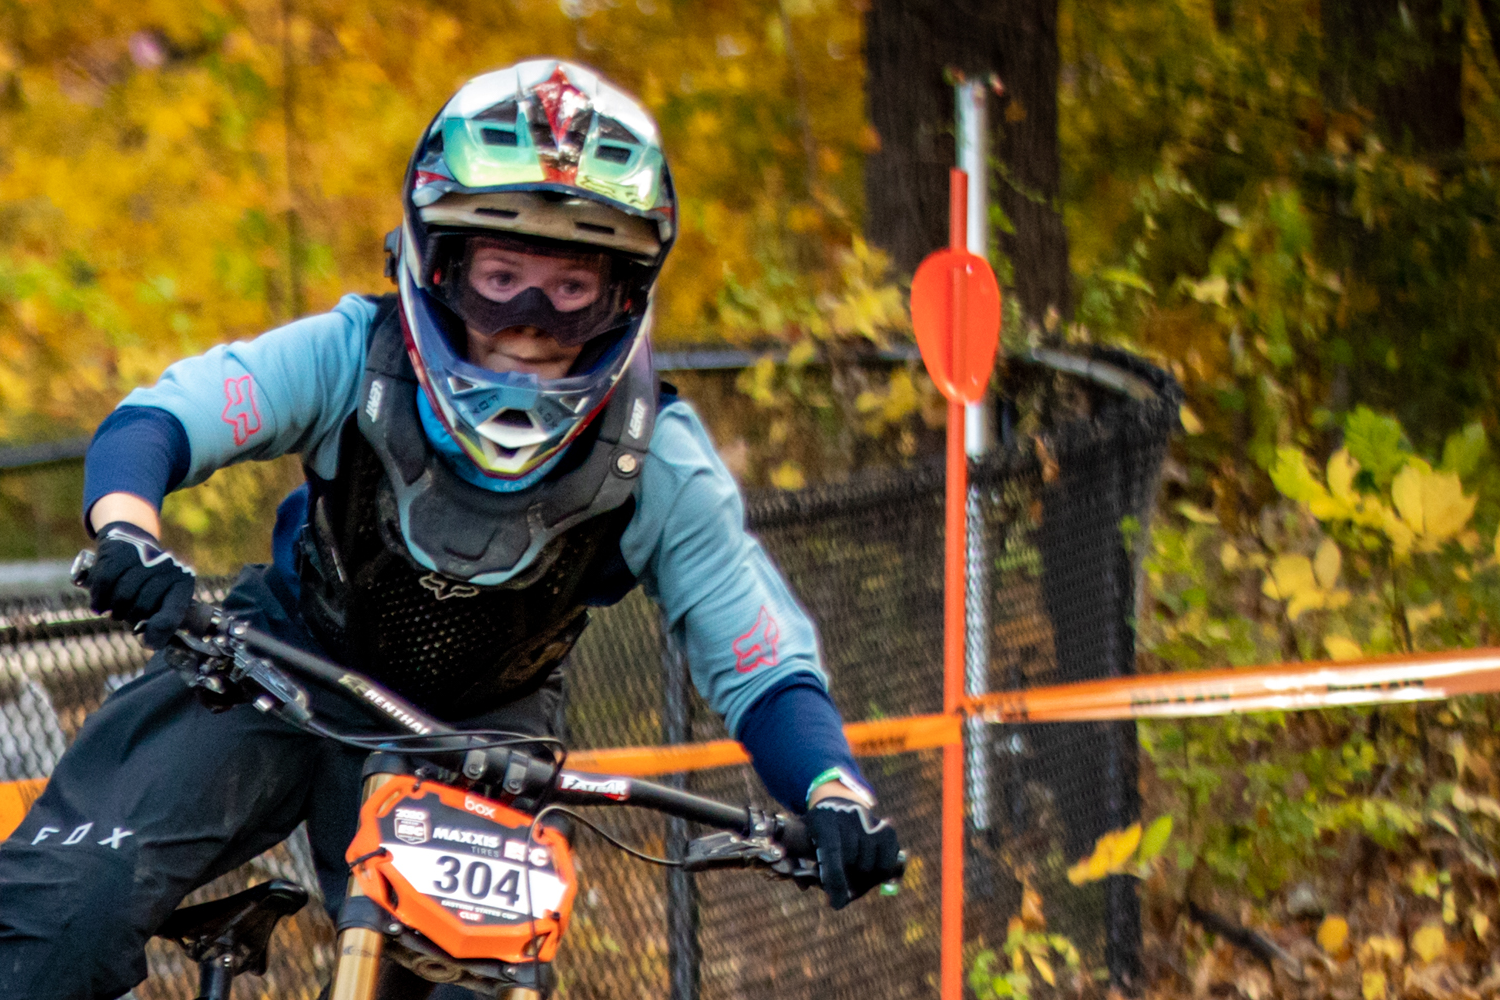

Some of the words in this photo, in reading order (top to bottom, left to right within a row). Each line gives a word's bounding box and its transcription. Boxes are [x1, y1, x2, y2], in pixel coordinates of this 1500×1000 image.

[628, 398, 647, 440] LEATT
[464, 795, 496, 819] box
[31, 822, 135, 850] FOX
[432, 827, 500, 849] MAXXIS
[471, 846, 499, 858] TIRES
[432, 855, 521, 908] 304
[441, 900, 474, 912] EASTERN
[474, 907, 501, 917] STATES
[501, 912, 518, 921] CUP
